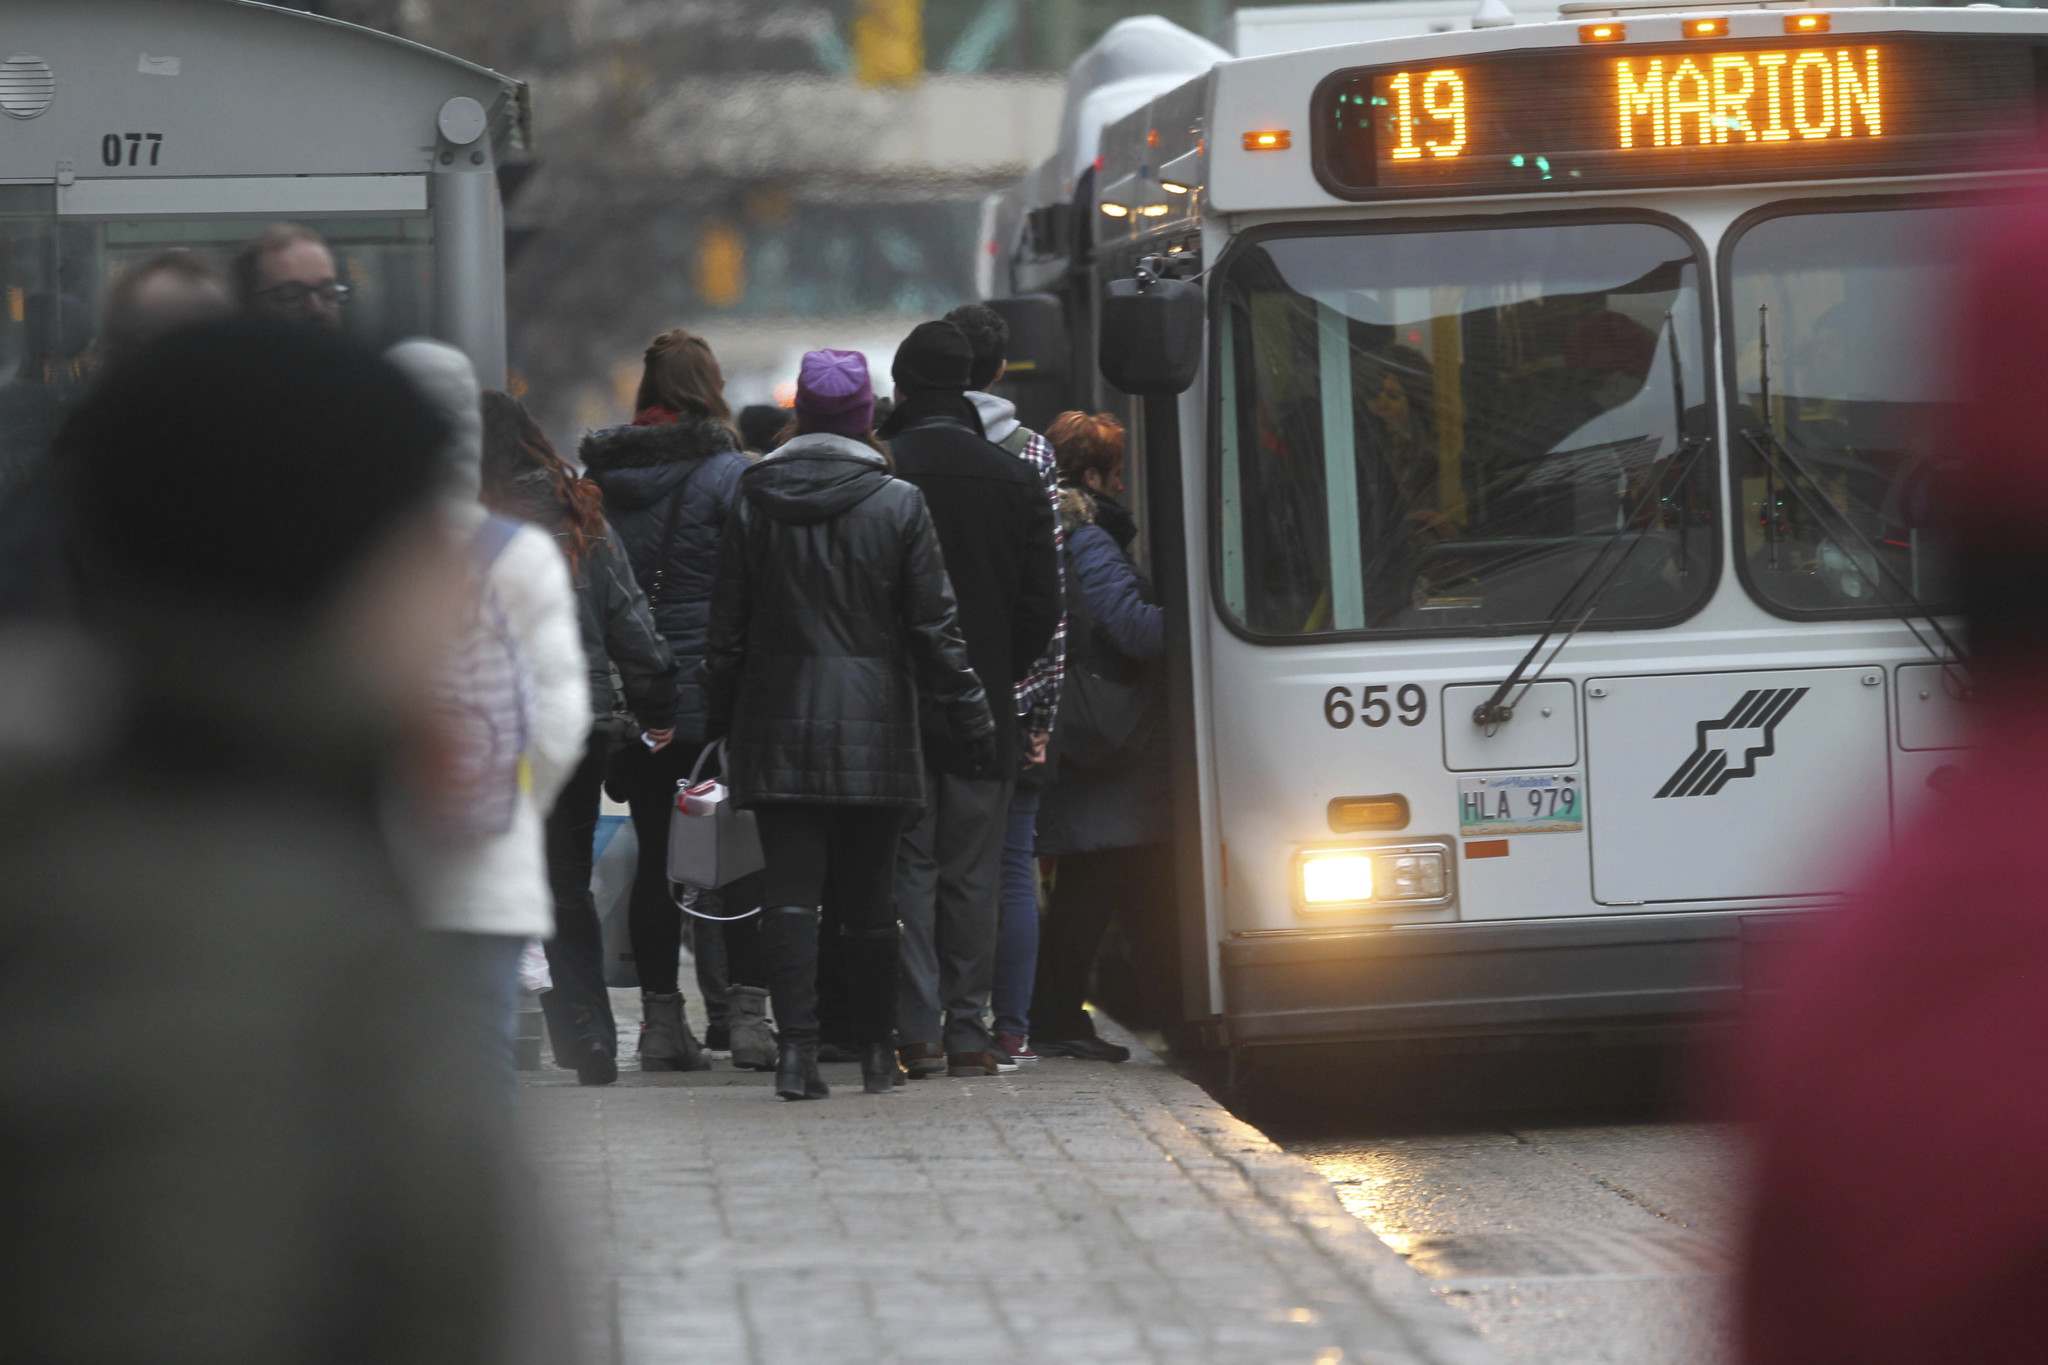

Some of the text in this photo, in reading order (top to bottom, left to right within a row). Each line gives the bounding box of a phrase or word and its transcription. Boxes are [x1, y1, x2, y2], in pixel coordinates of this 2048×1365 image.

[1390, 48, 1882, 159] 19 MARION
[102, 133, 162, 166] 077
[1324, 683, 1427, 730] 659
[1463, 787, 1576, 820] HLA 979
